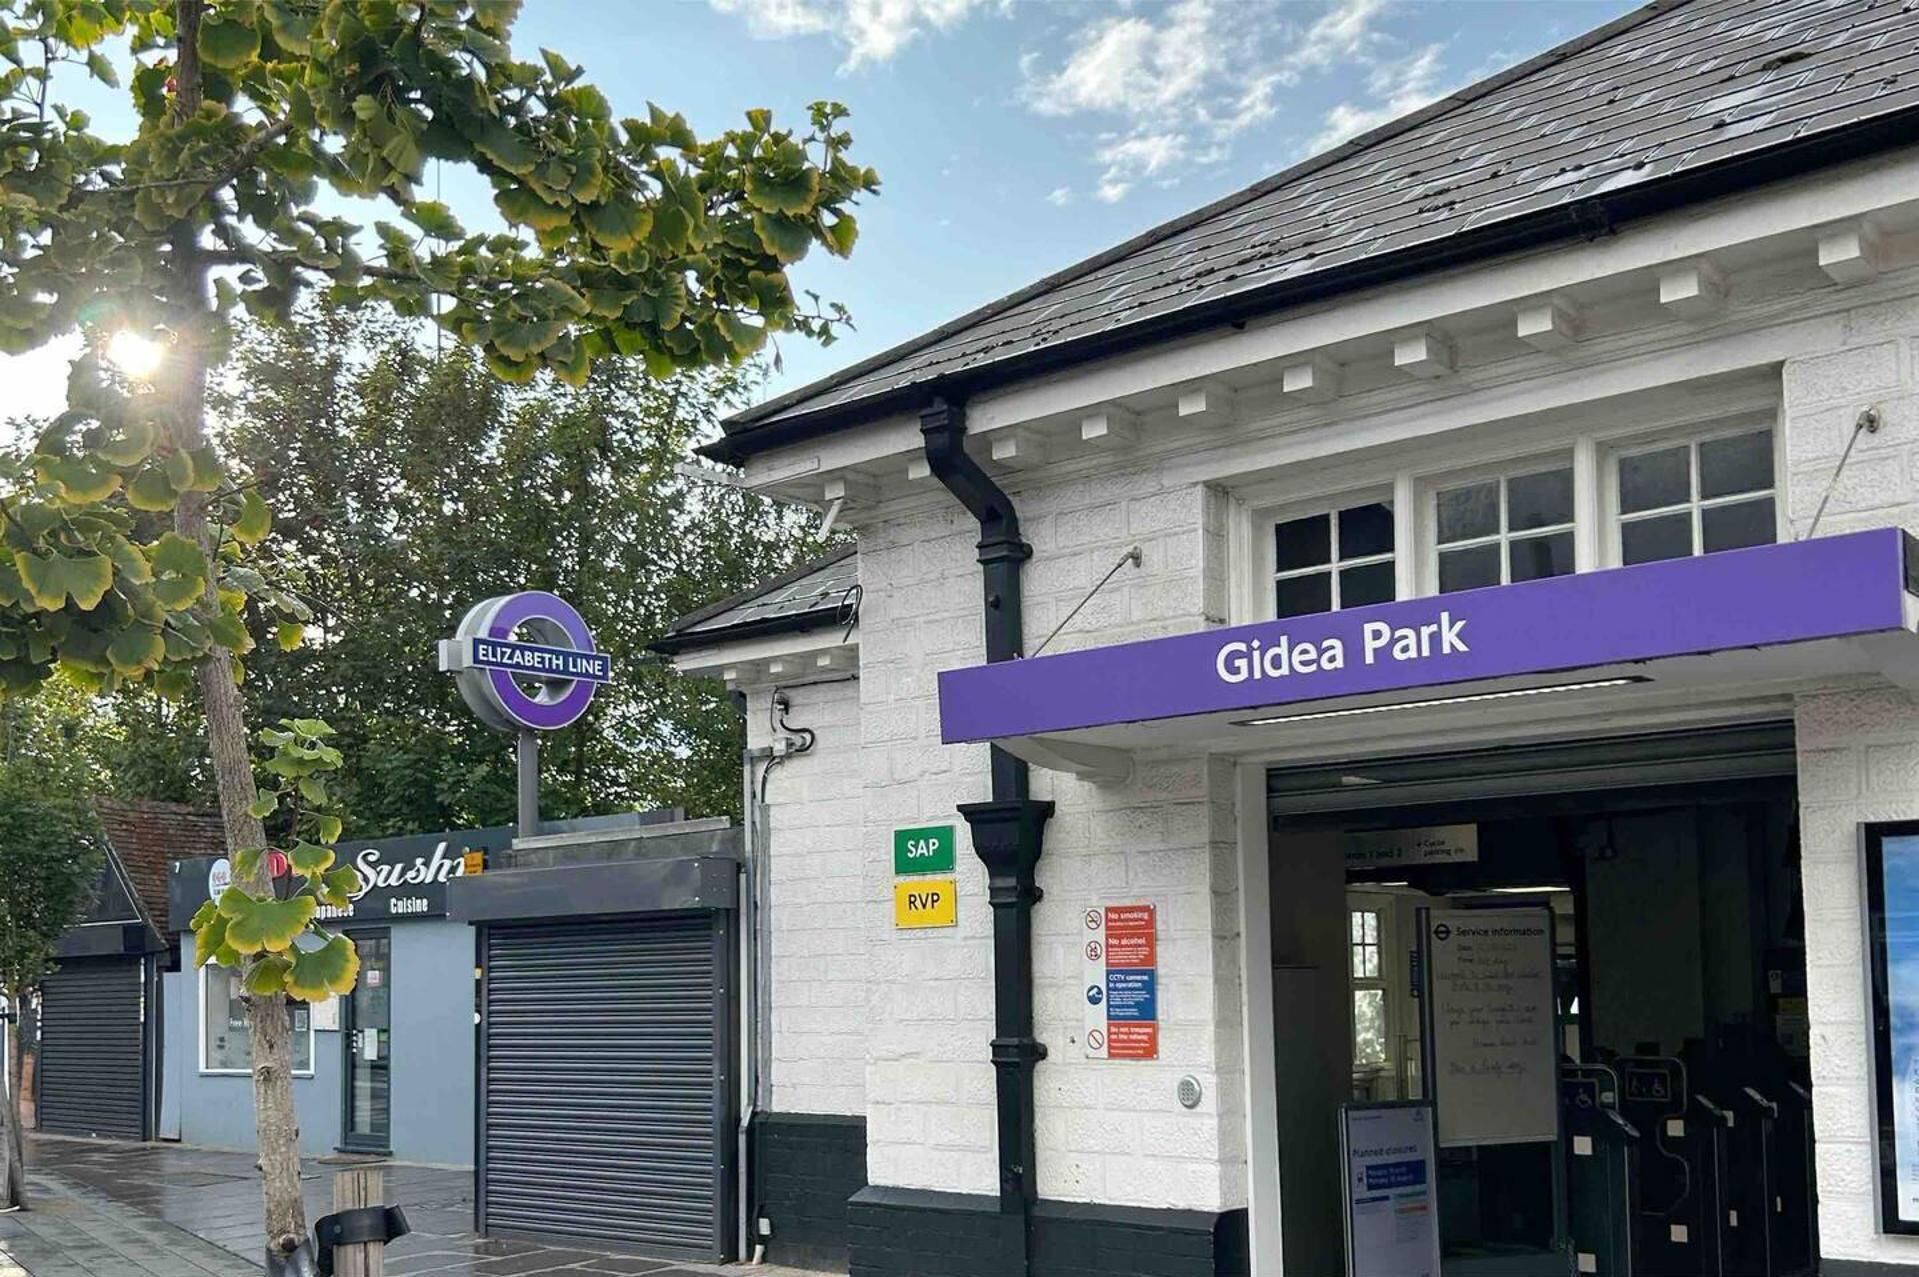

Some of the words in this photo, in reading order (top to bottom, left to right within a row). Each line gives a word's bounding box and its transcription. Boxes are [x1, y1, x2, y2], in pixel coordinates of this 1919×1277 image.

[1215, 635, 1345, 684] Gidea
[1362, 612, 1470, 665] Park
[478, 644, 564, 671] ELIZABETH
[568, 656, 604, 676] LINE
[907, 838, 940, 858] SAP
[346, 841, 465, 901] Sushi
[312, 903, 355, 921] apanese
[390, 896, 428, 914] Cuisine
[908, 892, 941, 912] RVP
[1107, 911, 1119, 920] No
[1120, 911, 1149, 921] smoking
[1108, 937, 1120, 945] No
[1120, 936, 1146, 946] alcohol
[1455, 926, 1490, 937] Service
[1491, 926, 1545, 937] information
[1115, 981, 1143, 989] operation
[1352, 1145, 1384, 1159] Planned
